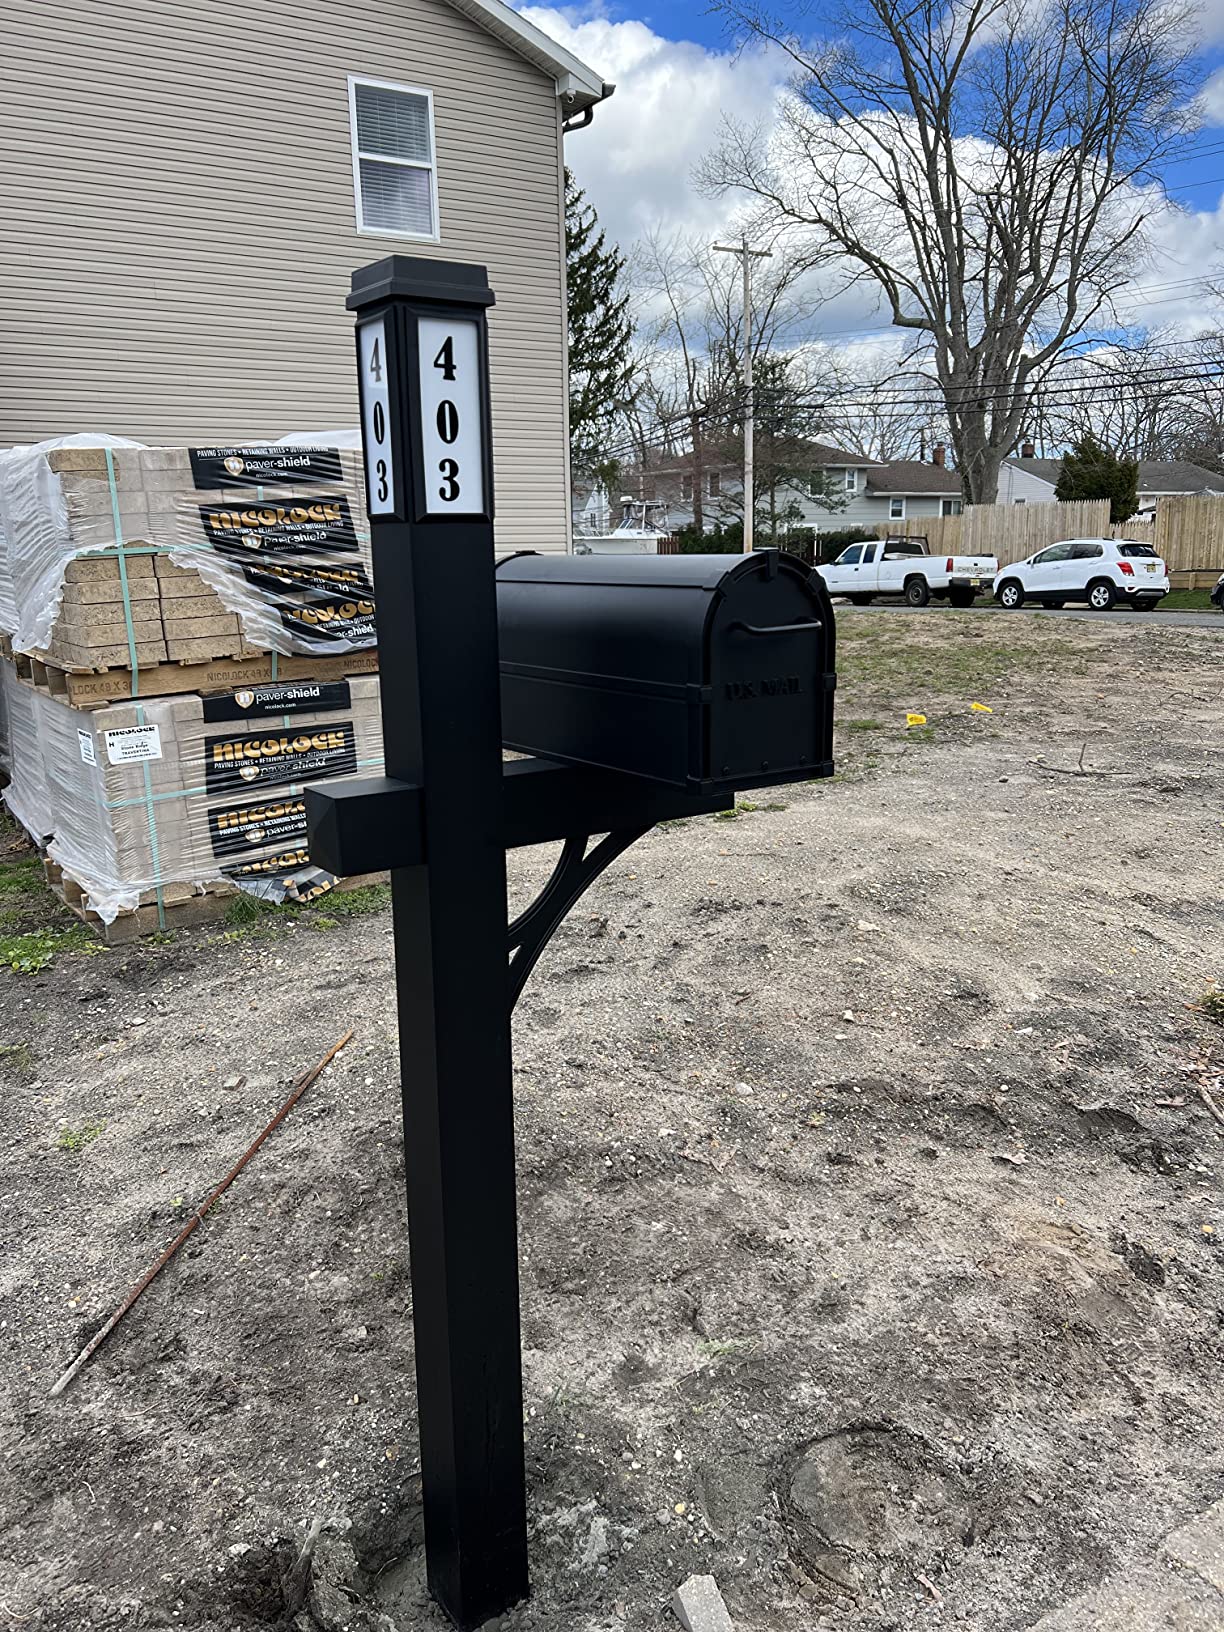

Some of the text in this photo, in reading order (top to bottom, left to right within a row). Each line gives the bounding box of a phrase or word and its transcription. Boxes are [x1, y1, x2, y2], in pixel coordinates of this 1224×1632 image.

[370, 337, 389, 502] 403
[433, 336, 460, 502] 403
[196, 449, 217, 457] PAVING
[217, 448, 238, 457] STONES
[245, 456, 311, 472] paver-shield
[207, 670, 249, 681] NICOLOCK
[256, 687, 321, 704] paver-shield
[264, 702, 297, 710] nicolock.com
[214, 761, 234, 769] PAVING
[234, 759, 254, 767] STONES
[259, 756, 285, 764] RETAINING
